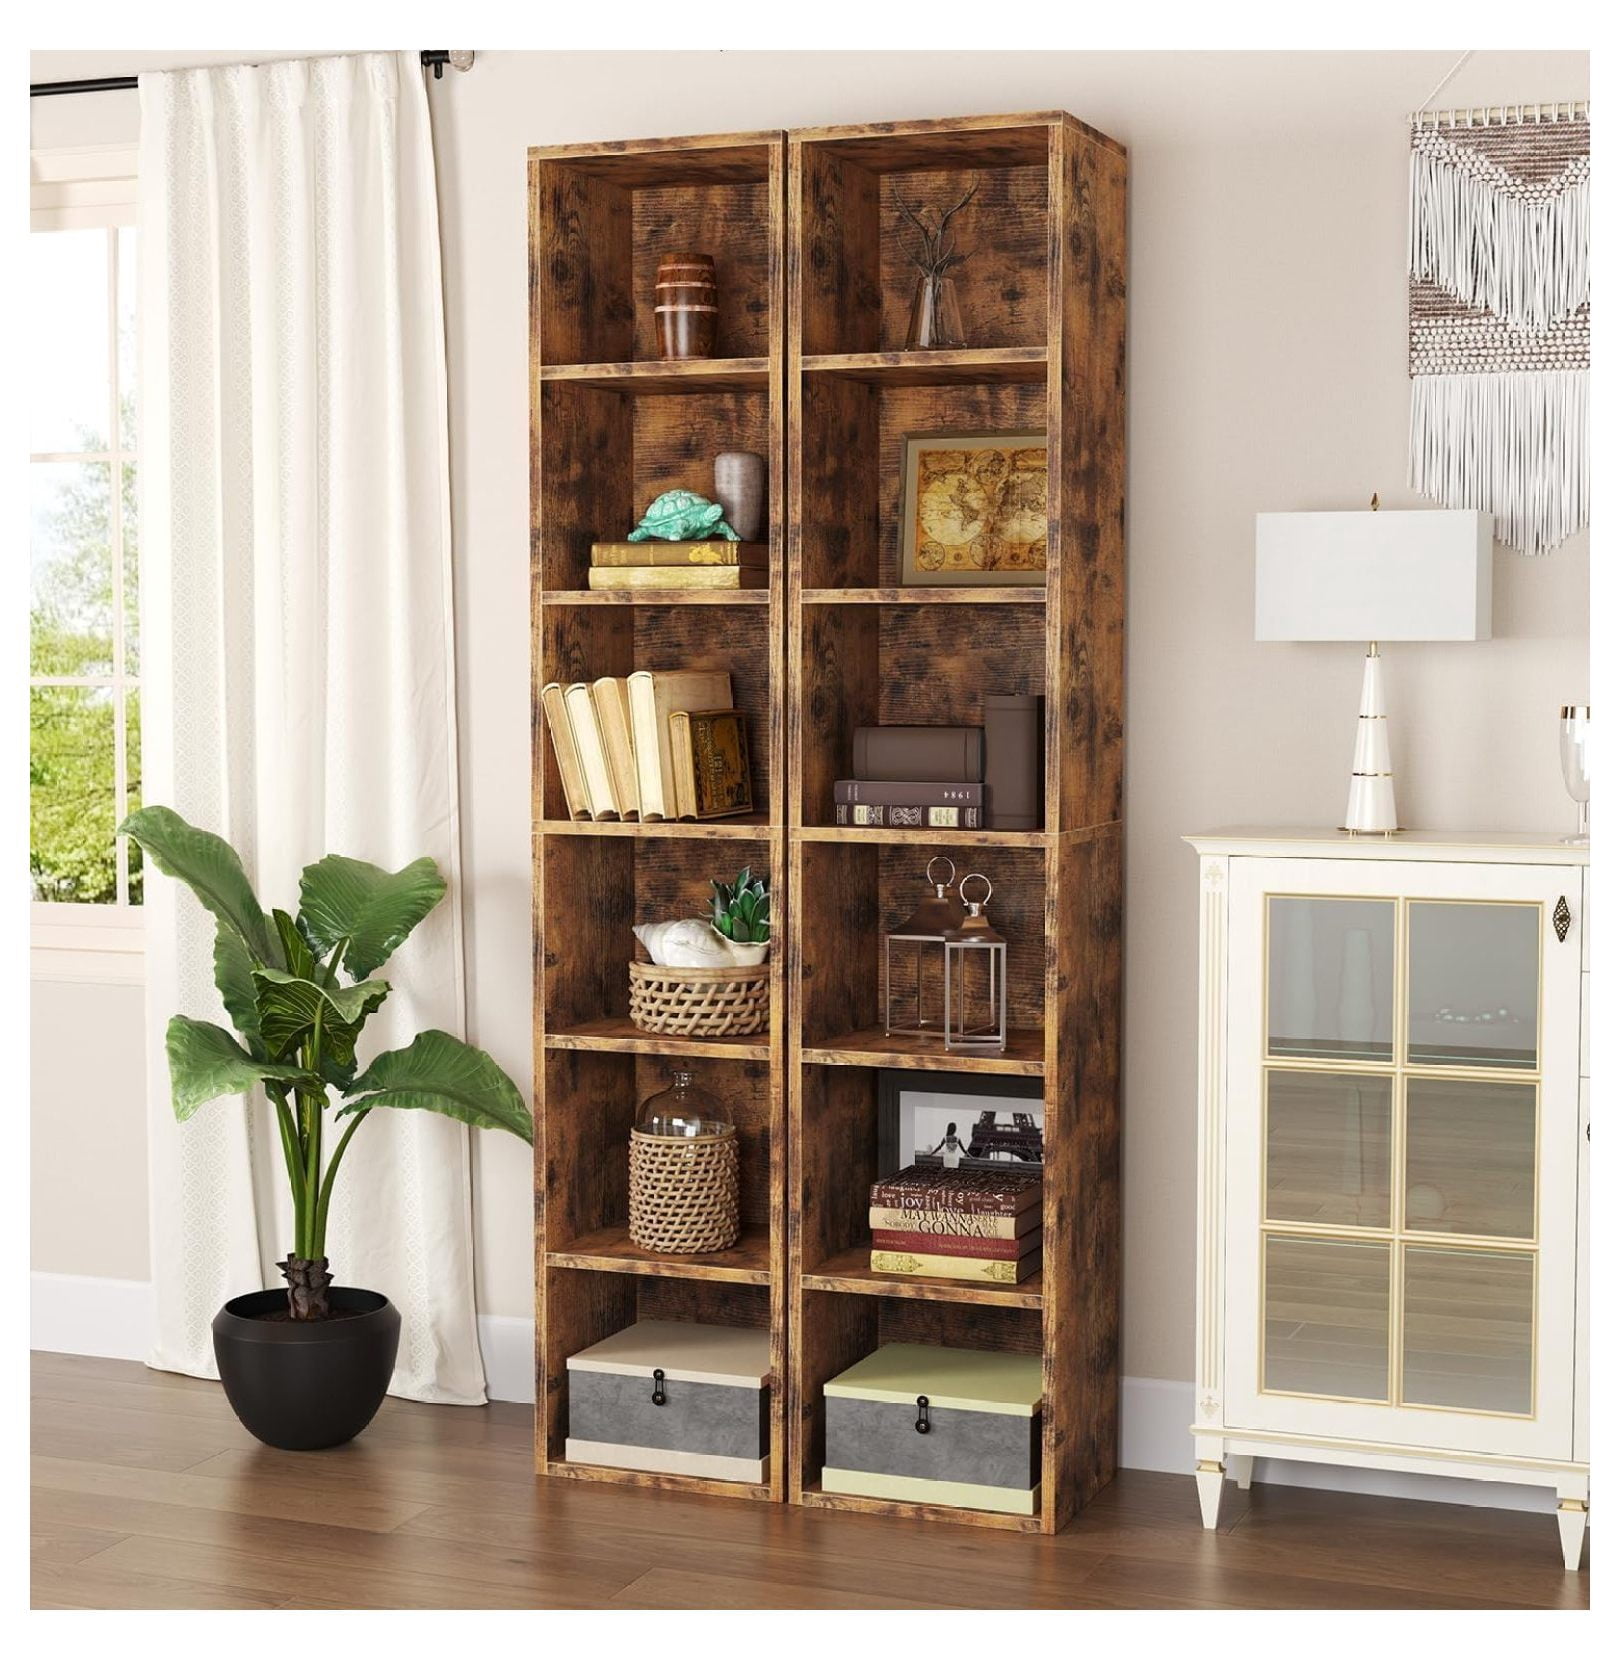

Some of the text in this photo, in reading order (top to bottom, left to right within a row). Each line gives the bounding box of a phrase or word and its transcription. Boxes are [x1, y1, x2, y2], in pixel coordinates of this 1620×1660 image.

[944, 791, 970, 800] 1984
[900, 1192, 923, 1210] joy
[919, 1220, 986, 1238] GONNA
